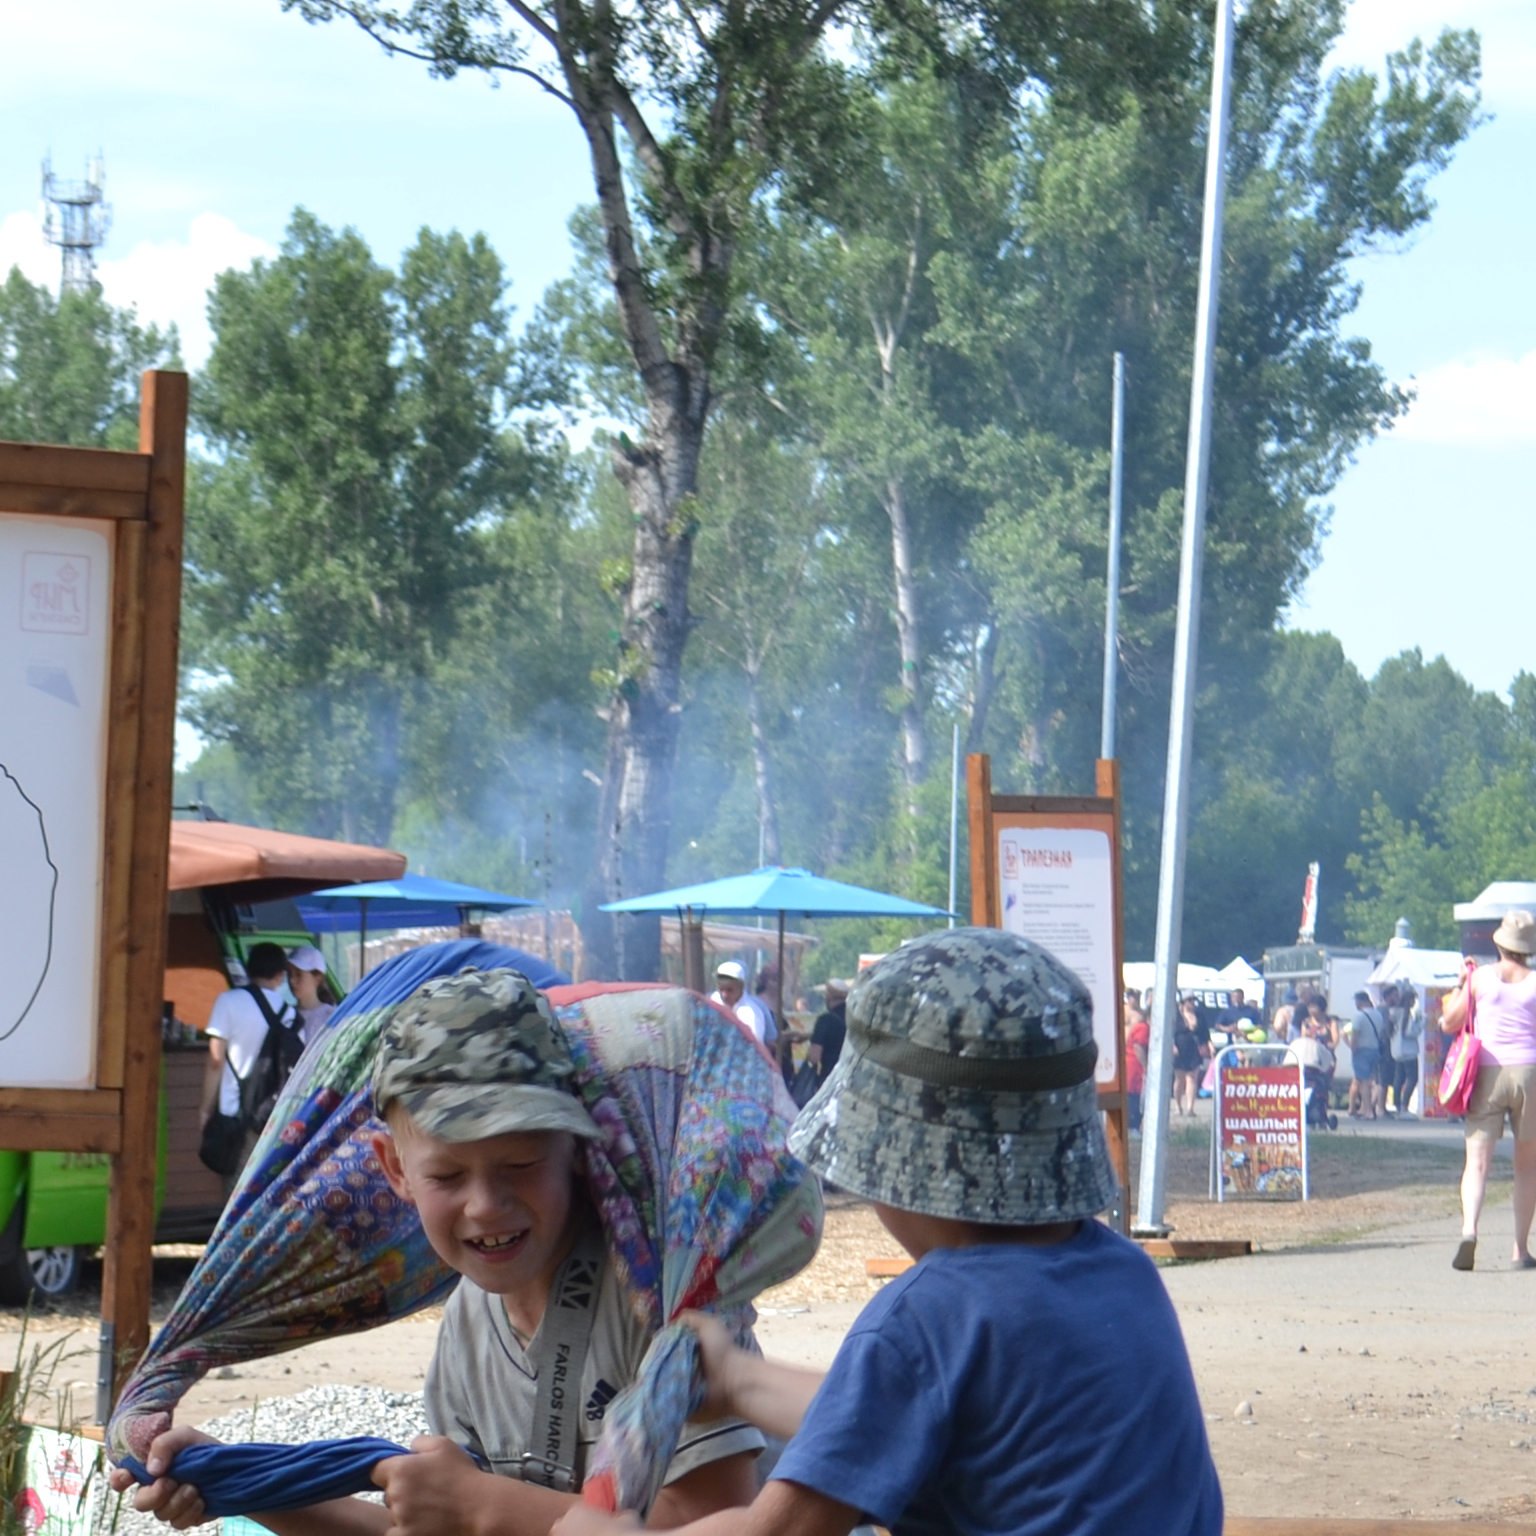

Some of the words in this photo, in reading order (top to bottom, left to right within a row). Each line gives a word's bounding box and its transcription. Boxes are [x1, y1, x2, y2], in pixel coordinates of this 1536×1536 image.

[1224, 1083, 1298, 1099] ПОЛЯНКА
[1224, 1117, 1298, 1131] ШАШЛЫК
[1255, 1132, 1298, 1145] ПЛОВ
[550, 1342, 571, 1411] FARLOS
